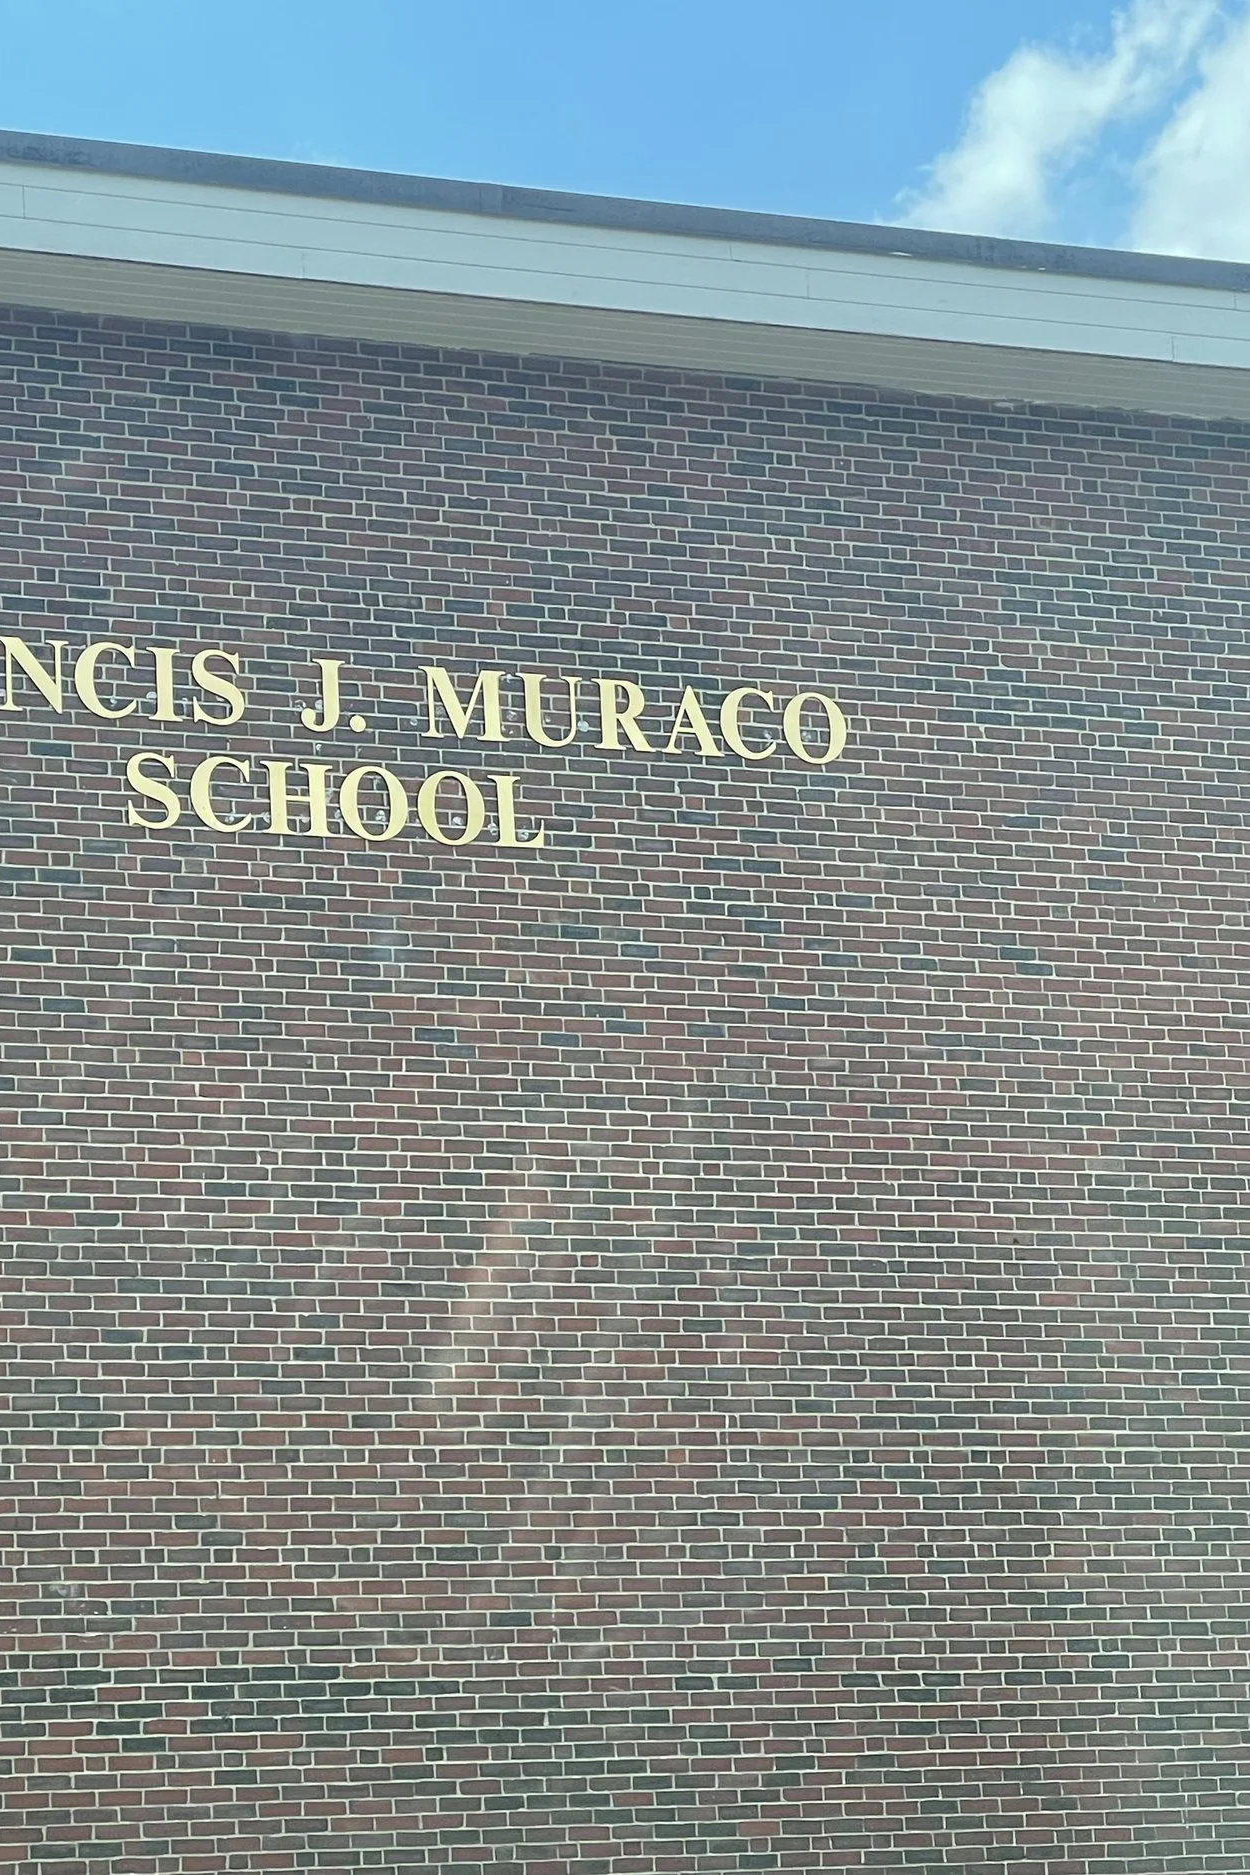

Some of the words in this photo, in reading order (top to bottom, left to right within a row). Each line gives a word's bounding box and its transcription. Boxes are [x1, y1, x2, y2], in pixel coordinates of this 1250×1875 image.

[301, 659, 366, 734] J.
[422, 666, 849, 765] MURACO
[126, 752, 547, 849] SCHOOL
